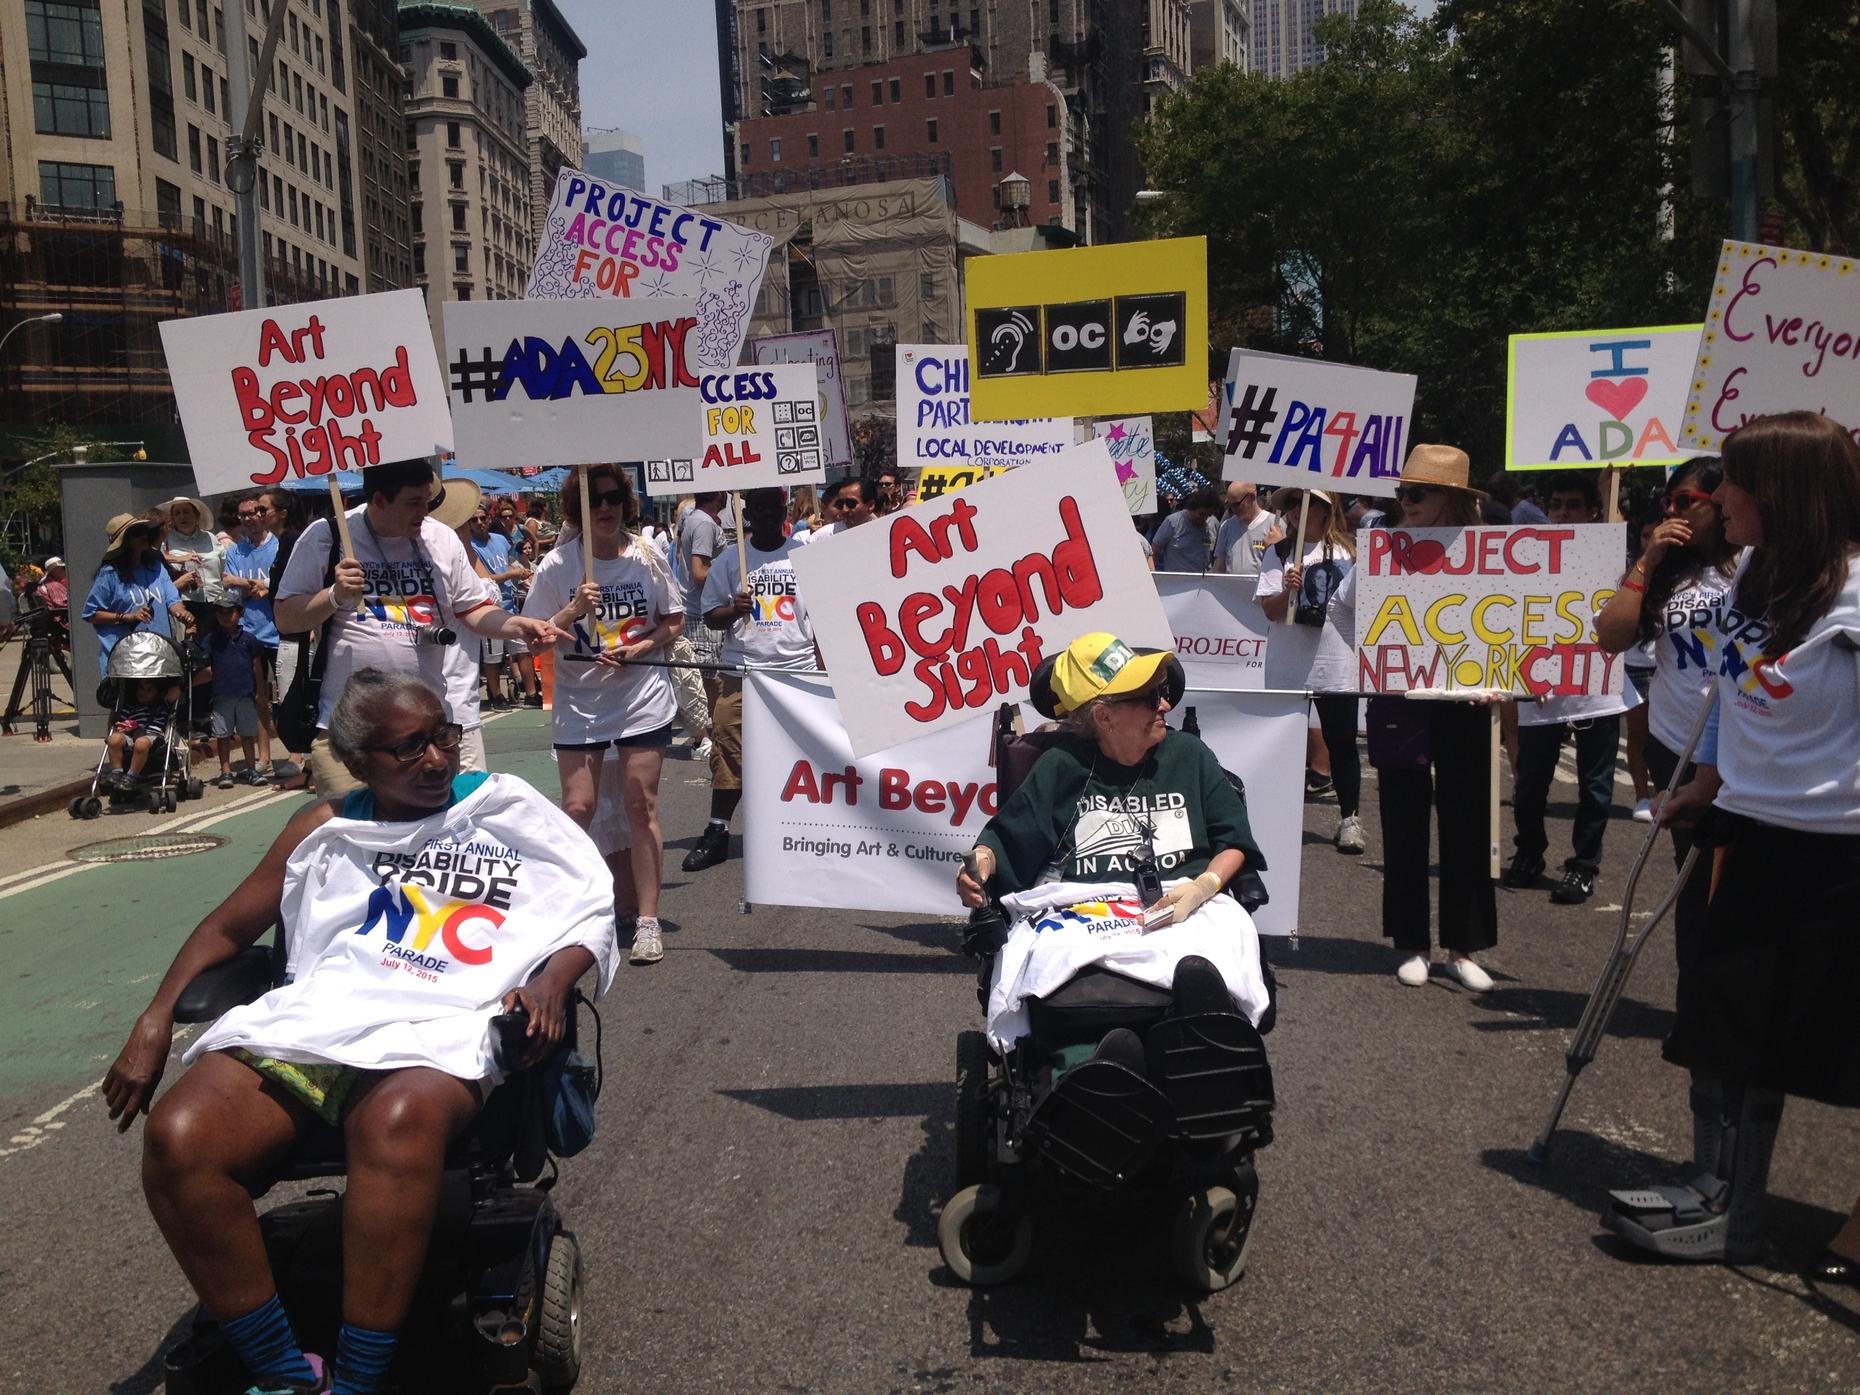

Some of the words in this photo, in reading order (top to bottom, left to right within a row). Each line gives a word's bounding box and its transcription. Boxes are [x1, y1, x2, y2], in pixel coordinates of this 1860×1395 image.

[565, 178, 722, 252] PROJECT
[563, 212, 683, 273] ACCESS
[572, 249, 640, 298] FOR
[258, 315, 325, 367] Art
[1052, 322, 1105, 351] OC
[450, 317, 699, 404] #ADA25NYC
[1590, 340, 1651, 378] I
[231, 345, 417, 431] Beyond
[700, 372, 778, 404] CCESS
[915, 357, 969, 396] CHI
[706, 405, 757, 436] FOR
[798, 407, 813, 415] OC
[1225, 384, 1404, 478] #PA4ALL
[1550, 417, 1678, 461] ADA
[248, 418, 382, 485] Sight
[702, 440, 761, 469] ALL
[917, 437, 971, 458] LOCAL
[974, 440, 1064, 456] DEVELOPMENT
[967, 457, 1031, 466] CORPORATION
[890, 498, 978, 579] Art
[1369, 528, 1575, 576] PROJECT
[615, 582, 643, 591] ANNUA
[748, 574, 796, 584] ISABILITY
[857, 495, 1103, 676] Beyond
[1667, 594, 1726, 611] DISABI
[905, 626, 1044, 723] Sight
[1246, 661, 1263, 669] FOR
[780, 759, 864, 806] Art
[879, 768, 999, 827] Beyo
[1077, 792, 1185, 818] DISABLED
[374, 851, 522, 877] DISABILITY
[423, 838, 461, 851] FIRST
[465, 841, 523, 862] ANNUAL
[783, 836, 852, 858] Bringing
[857, 840, 883, 857] Art
[887, 843, 900, 858] &
[905, 844, 963, 864] Culture
[1076, 856, 1097, 875] IN
[354, 885, 507, 966] NYC
[380, 957, 400, 970] July
[415, 968, 439, 983] 2015
[382, 942, 449, 973] PARADE
